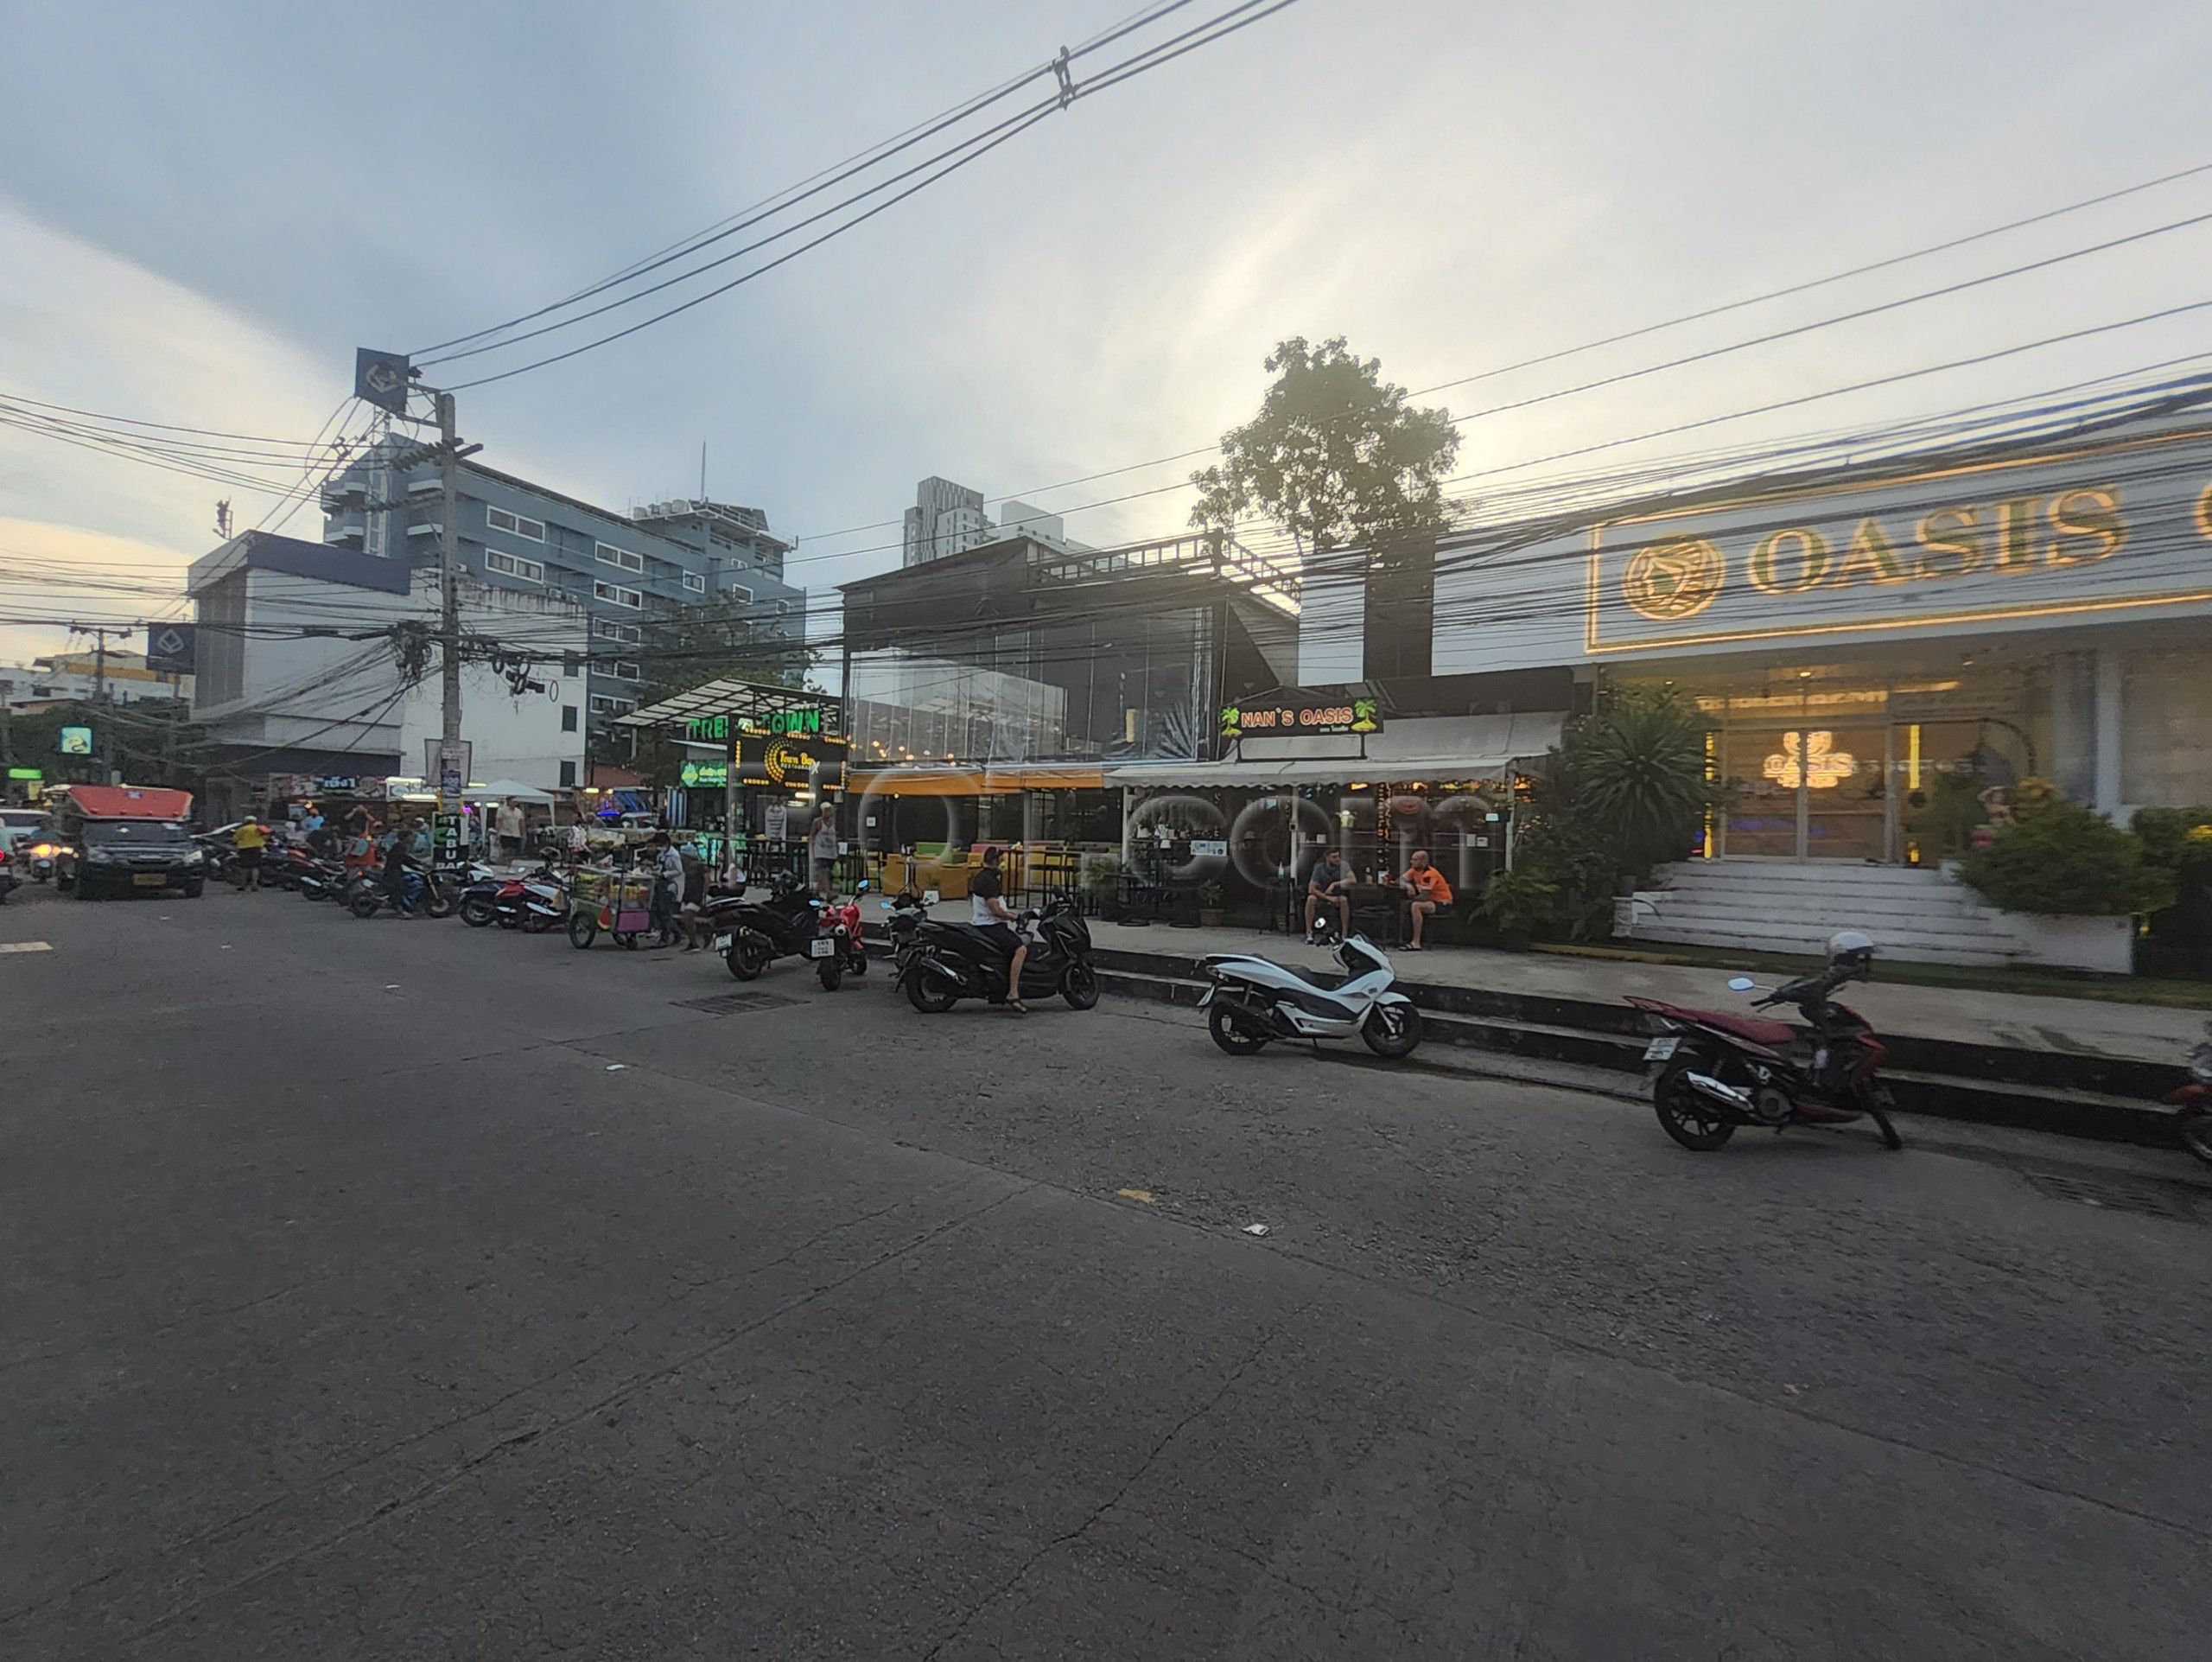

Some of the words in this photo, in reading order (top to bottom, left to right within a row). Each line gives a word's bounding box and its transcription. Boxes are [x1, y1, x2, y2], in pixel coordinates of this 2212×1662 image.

[1750, 486, 2127, 595] OASIS
[685, 716, 729, 740] TRE
[1299, 706, 1354, 726] OASIS
[445, 815, 458, 860] TABU
